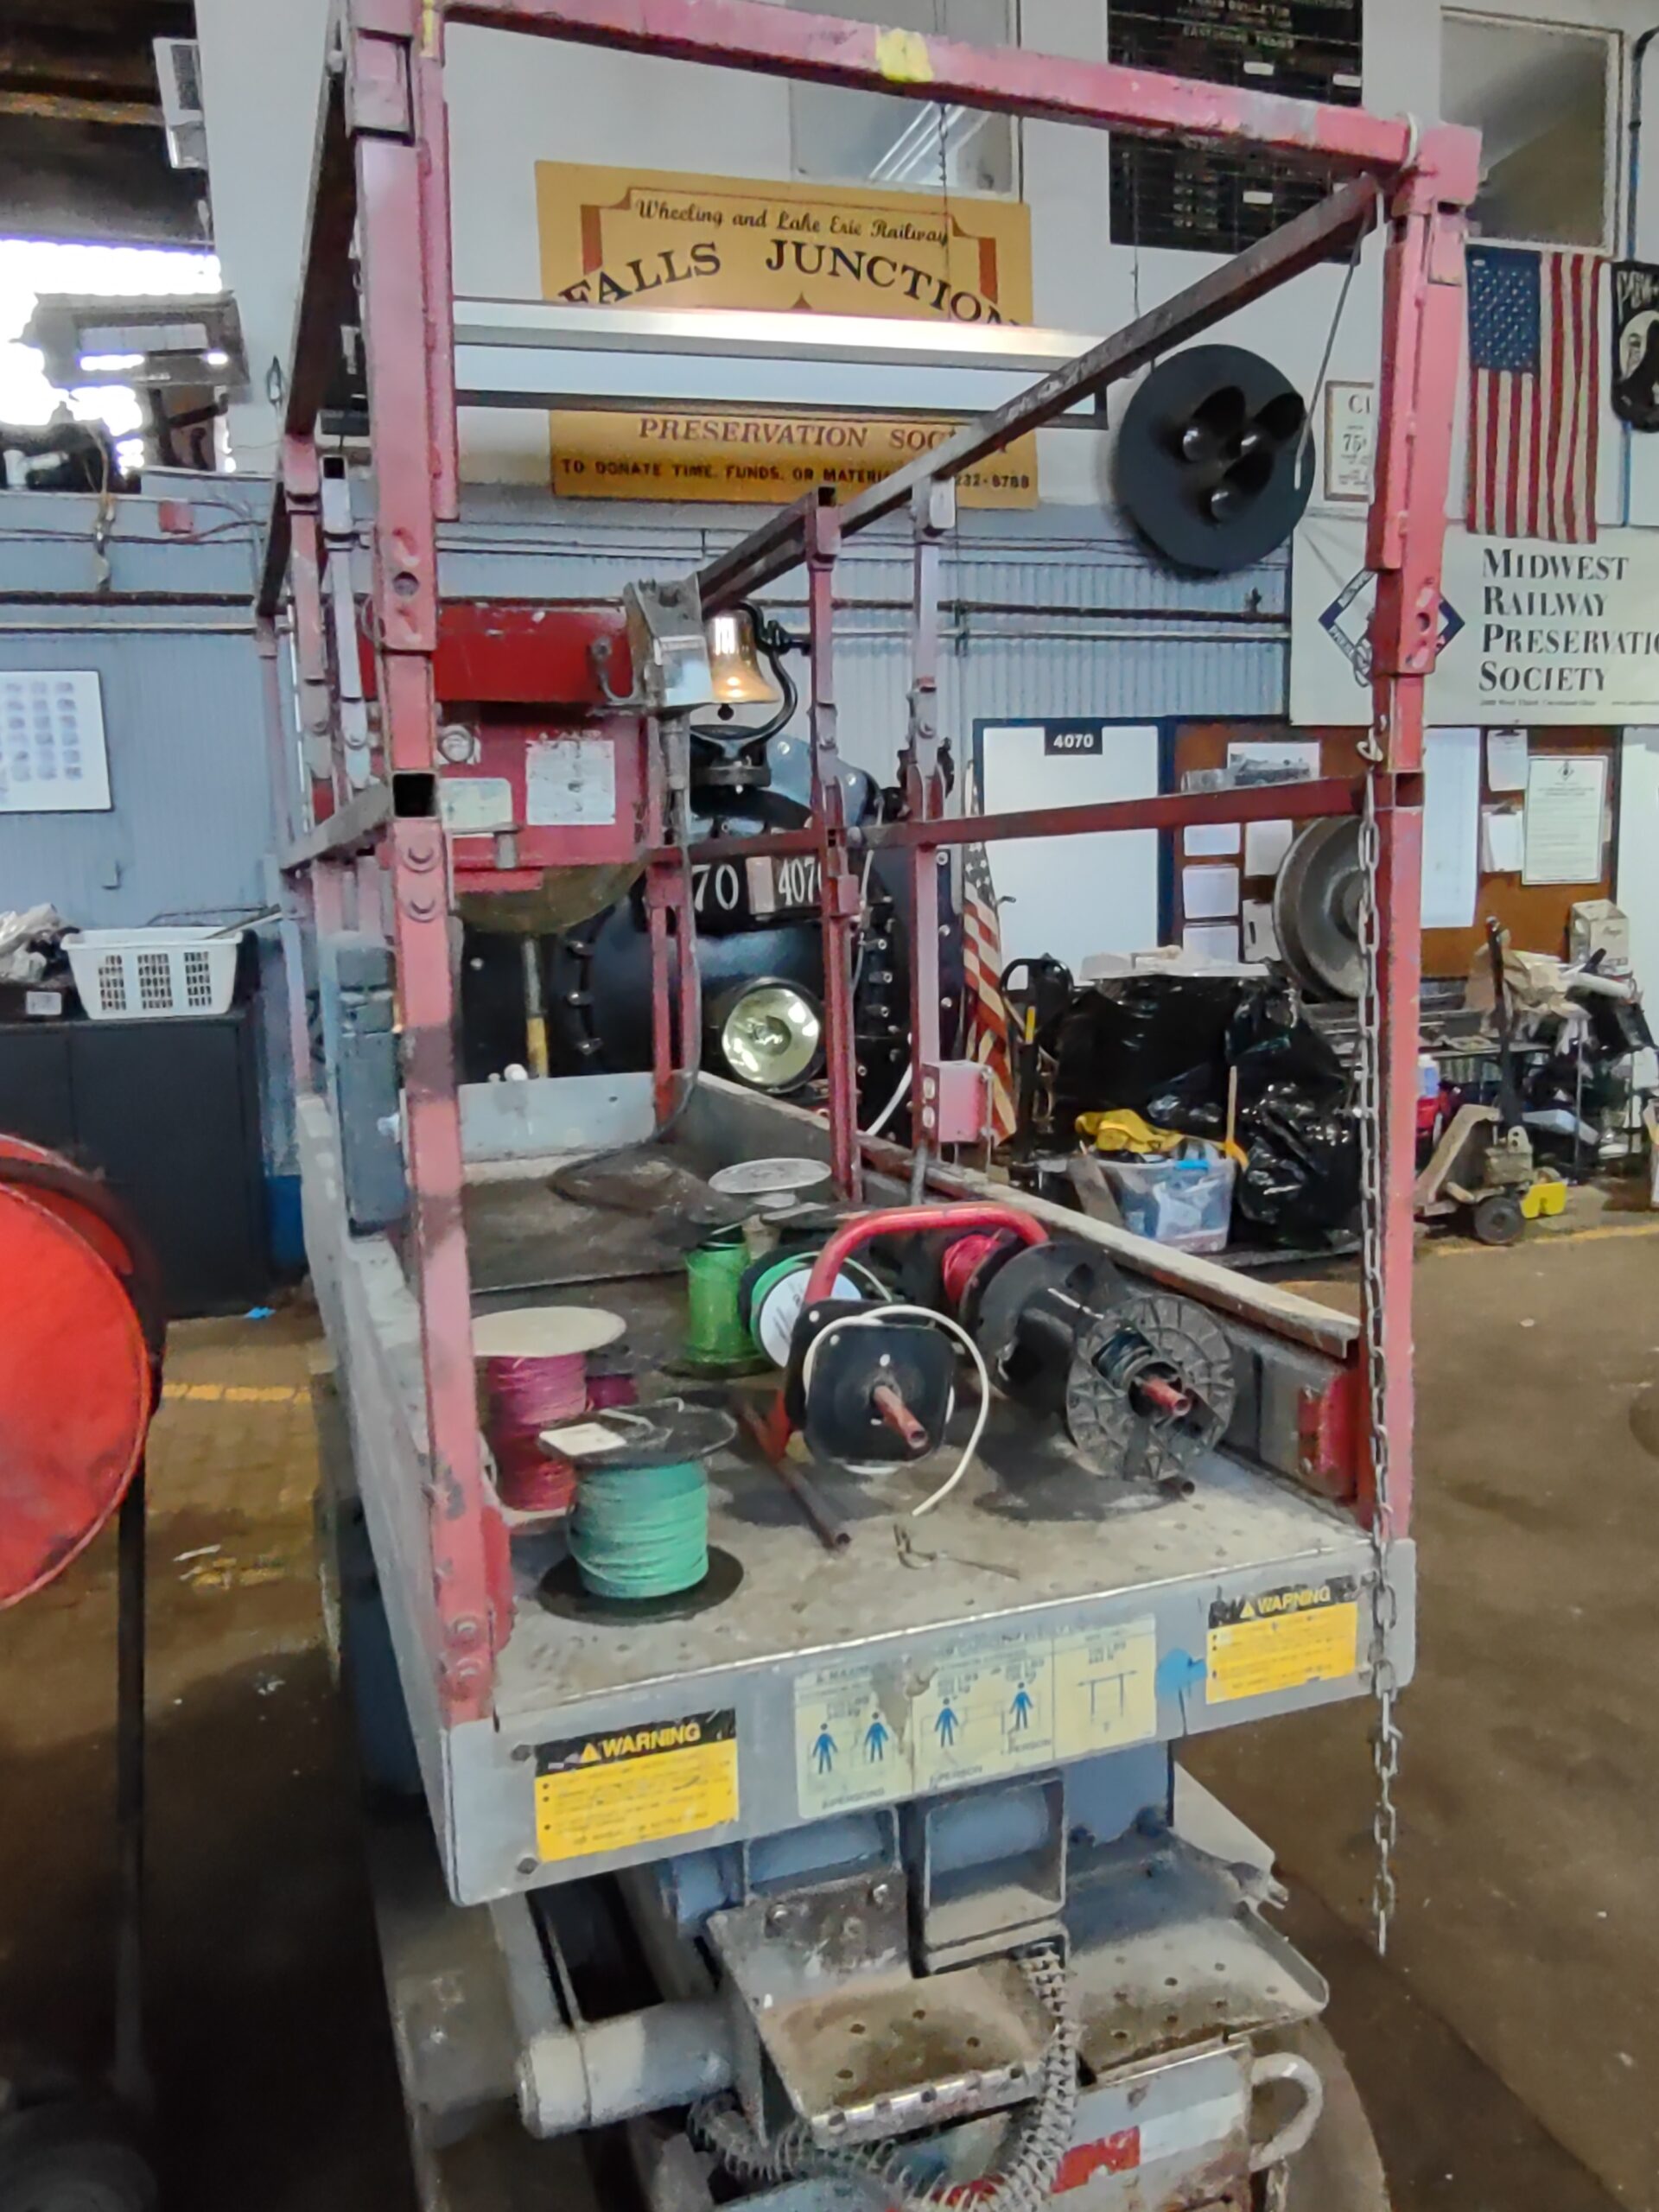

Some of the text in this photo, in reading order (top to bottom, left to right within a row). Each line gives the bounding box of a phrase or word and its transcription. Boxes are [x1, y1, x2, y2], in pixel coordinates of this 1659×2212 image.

[635, 199, 948, 247] Wheeling and Lake Erie Railway
[557, 241, 721, 305] FALLS
[639, 417, 868, 448] PRESERVATION
[561, 459, 585, 474] TO
[595, 461, 662, 477] DONATE
[791, 467, 814, 480] OR
[1483, 548, 1630, 581] MIDWEST
[1484, 586, 1608, 617] RAILWAY
[1478, 660, 1608, 691] SOCIETY
[1053, 734, 1094, 748] 4070
[1258, 1586, 1332, 1614] WARNING
[601, 1722, 701, 1758] WARNING
